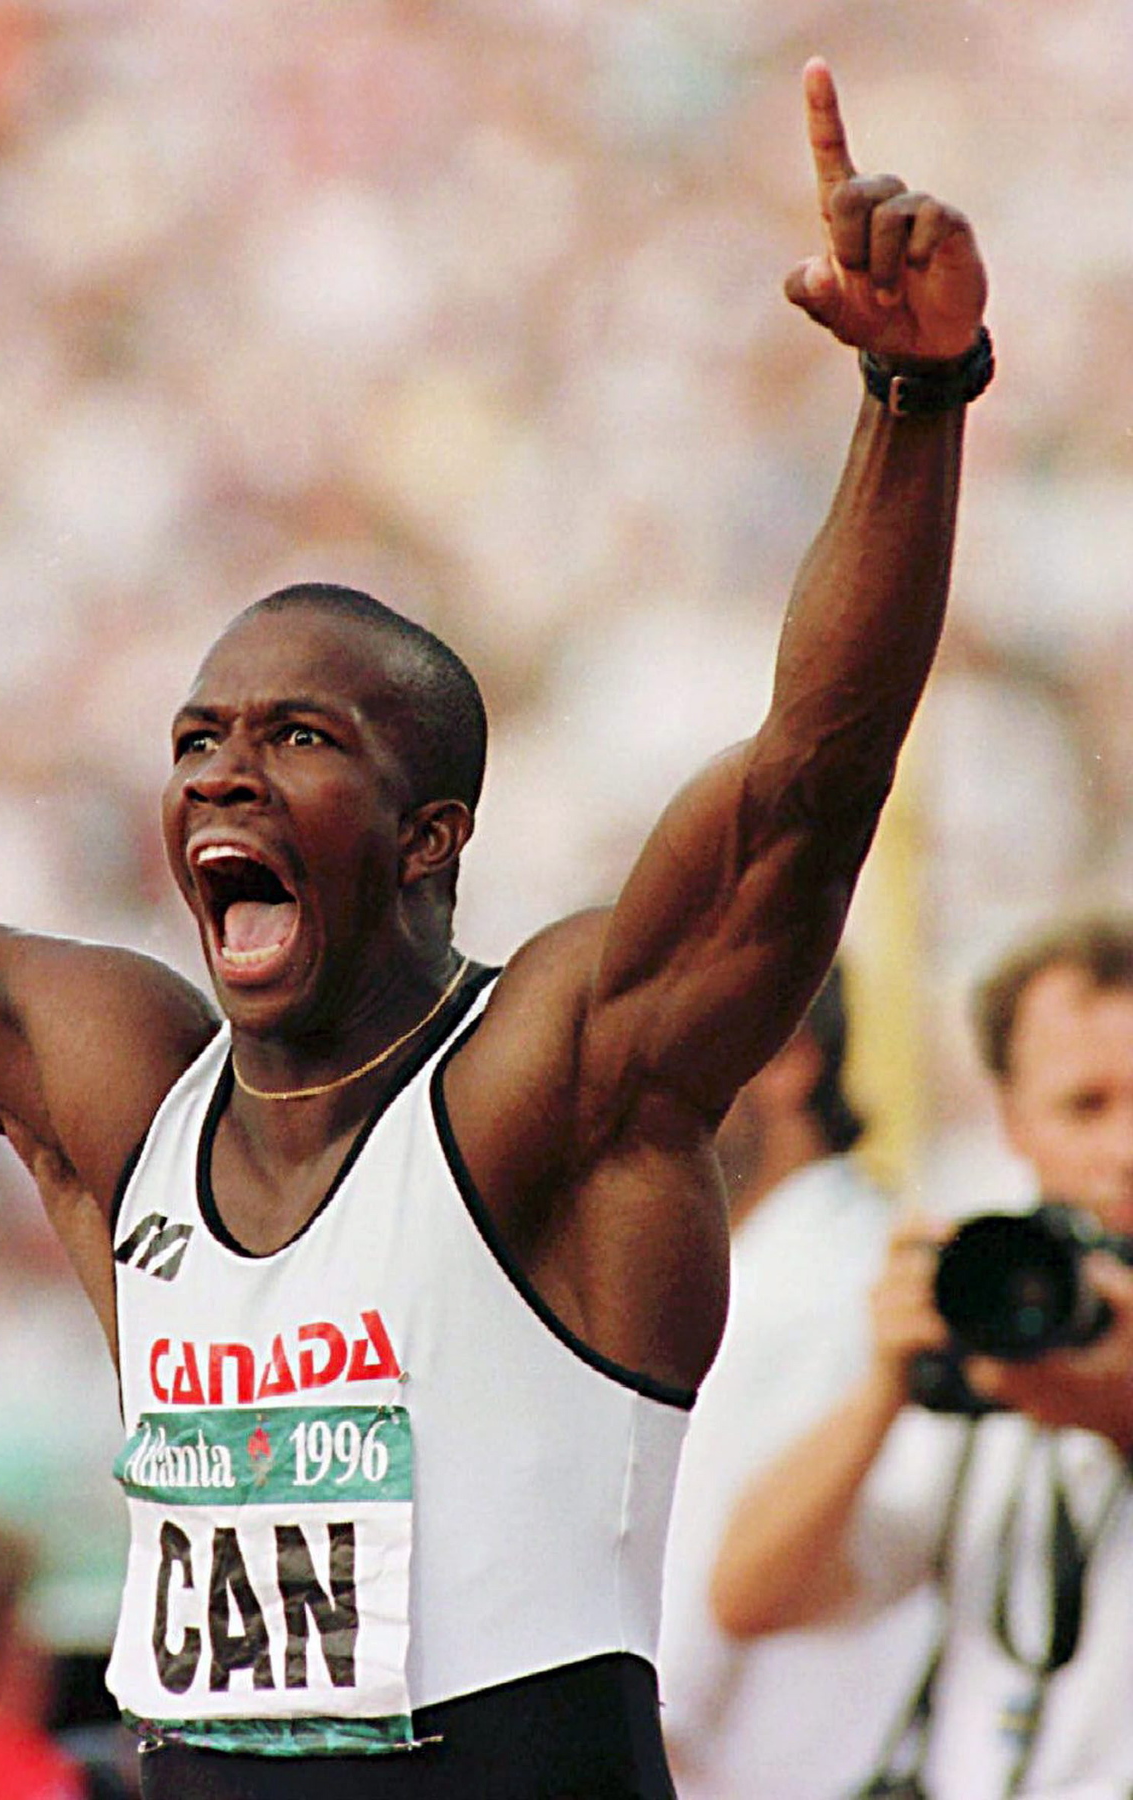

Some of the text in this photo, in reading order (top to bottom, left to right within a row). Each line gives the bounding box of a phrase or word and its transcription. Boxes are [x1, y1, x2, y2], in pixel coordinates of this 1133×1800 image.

[150, 1310, 400, 1404] CANADA
[289, 1420, 388, 1486] 1996
[153, 1520, 358, 1694] CAN
